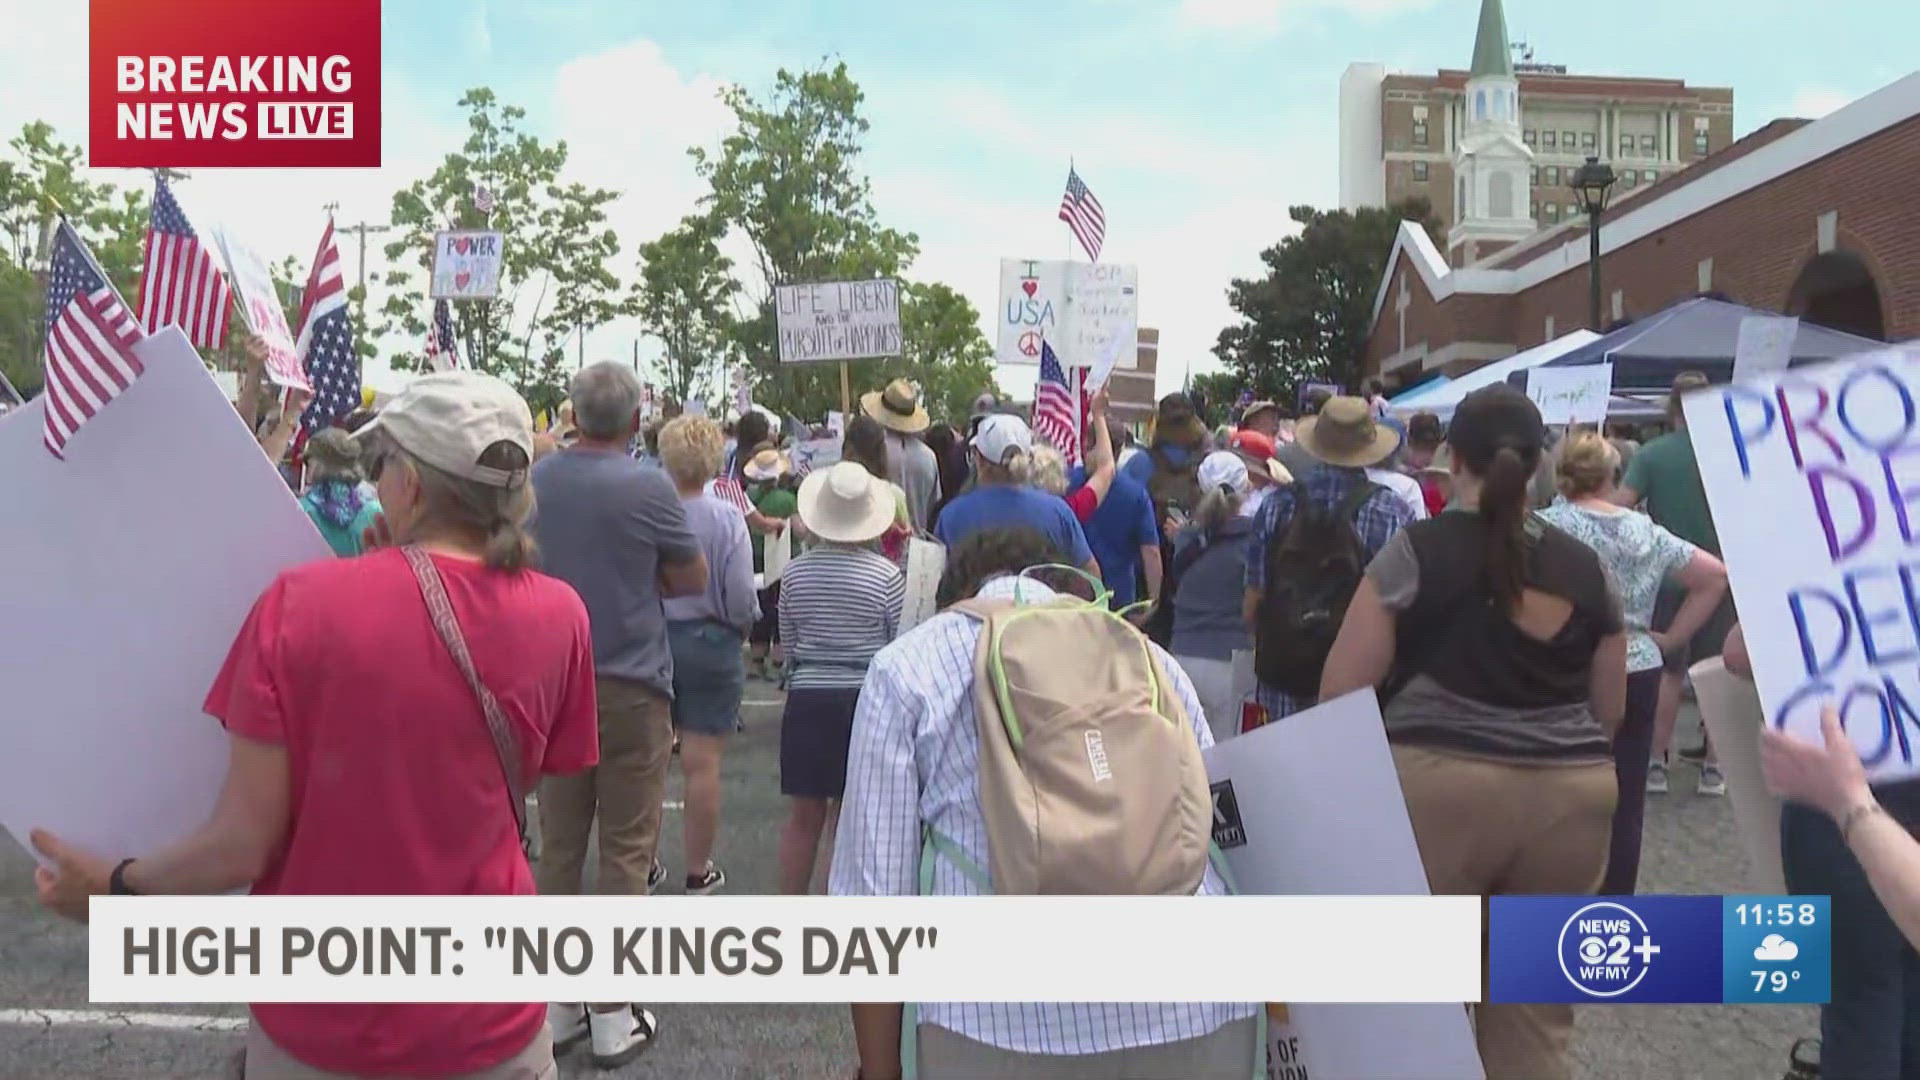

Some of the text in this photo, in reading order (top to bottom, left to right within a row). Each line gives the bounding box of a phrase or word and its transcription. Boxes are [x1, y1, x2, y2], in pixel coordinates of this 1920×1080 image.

[1019, 259, 1041, 280] I
[779, 285, 825, 316] LIFE
[1007, 298, 1056, 327] USA
[1277, 1036, 1298, 1064] OF
